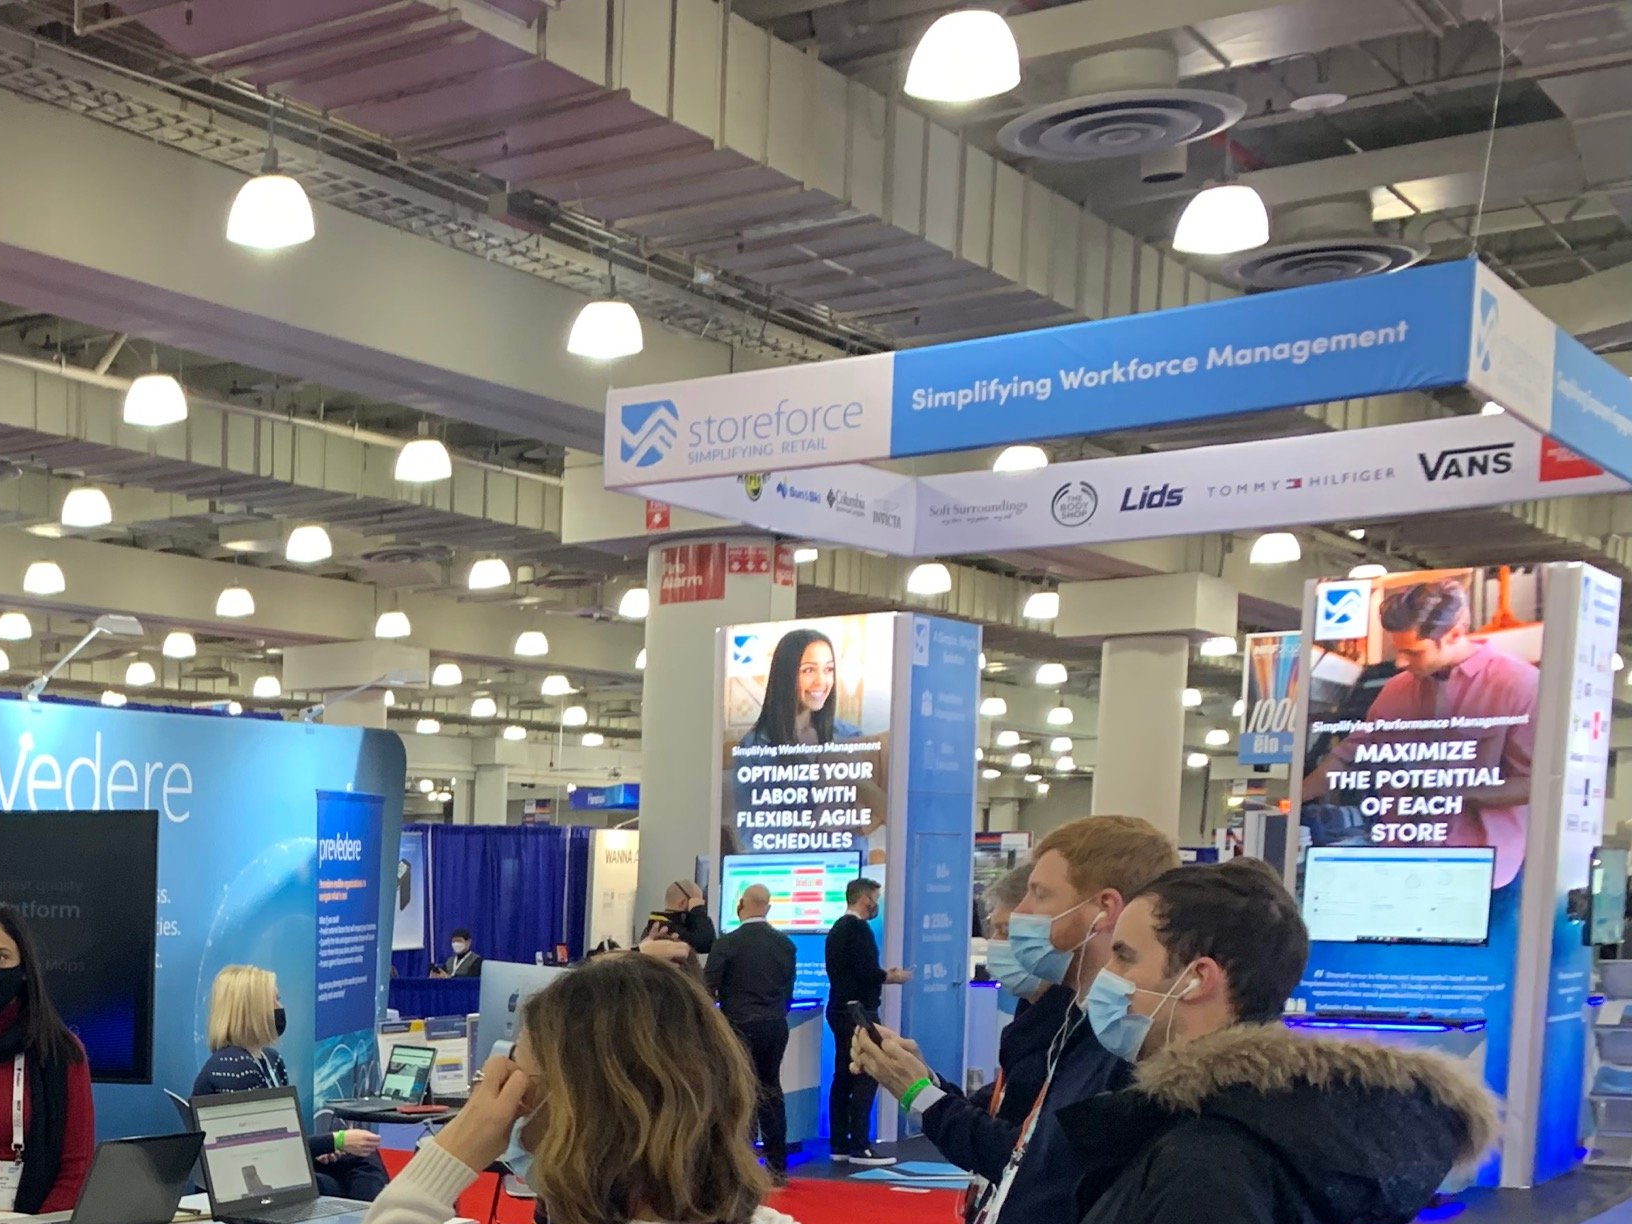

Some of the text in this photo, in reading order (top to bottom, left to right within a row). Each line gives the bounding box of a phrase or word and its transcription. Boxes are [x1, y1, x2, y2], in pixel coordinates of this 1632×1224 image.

[912, 320, 1409, 411] Simplifying Workforce Management
[688, 397, 864, 448] storeforce
[687, 437, 827, 466] SIMPLIFYING RETAIL
[1417, 442, 1515, 482] VANS
[1207, 466, 1396, 498] TOMMY HILFIGER
[929, 499, 1028, 518] Soft Surroundings
[1060, 501, 1090, 512] BODY
[1120, 483, 1185, 512] Lids
[872, 510, 902, 530] INVICTA
[1061, 511, 1088, 520] SHOP
[1313, 719, 1374, 734] Simplifying
[1374, 716, 1450, 731] Performance
[731, 744, 778, 758] Simplifying
[1354, 740, 1477, 764] MAXIMIZE
[736, 761, 874, 784] OPTIMIZE YOUR
[1326, 766, 1505, 790] THE POTENTIAL
[750, 785, 857, 806] LABOR WITH
[1360, 795, 1463, 817] OF EACH
[736, 808, 872, 830] FLEXIBLE, AGILE
[752, 831, 853, 850] SCHEDULES
[1370, 822, 1448, 842] STORE
[318, 832, 361, 868] prevedere
